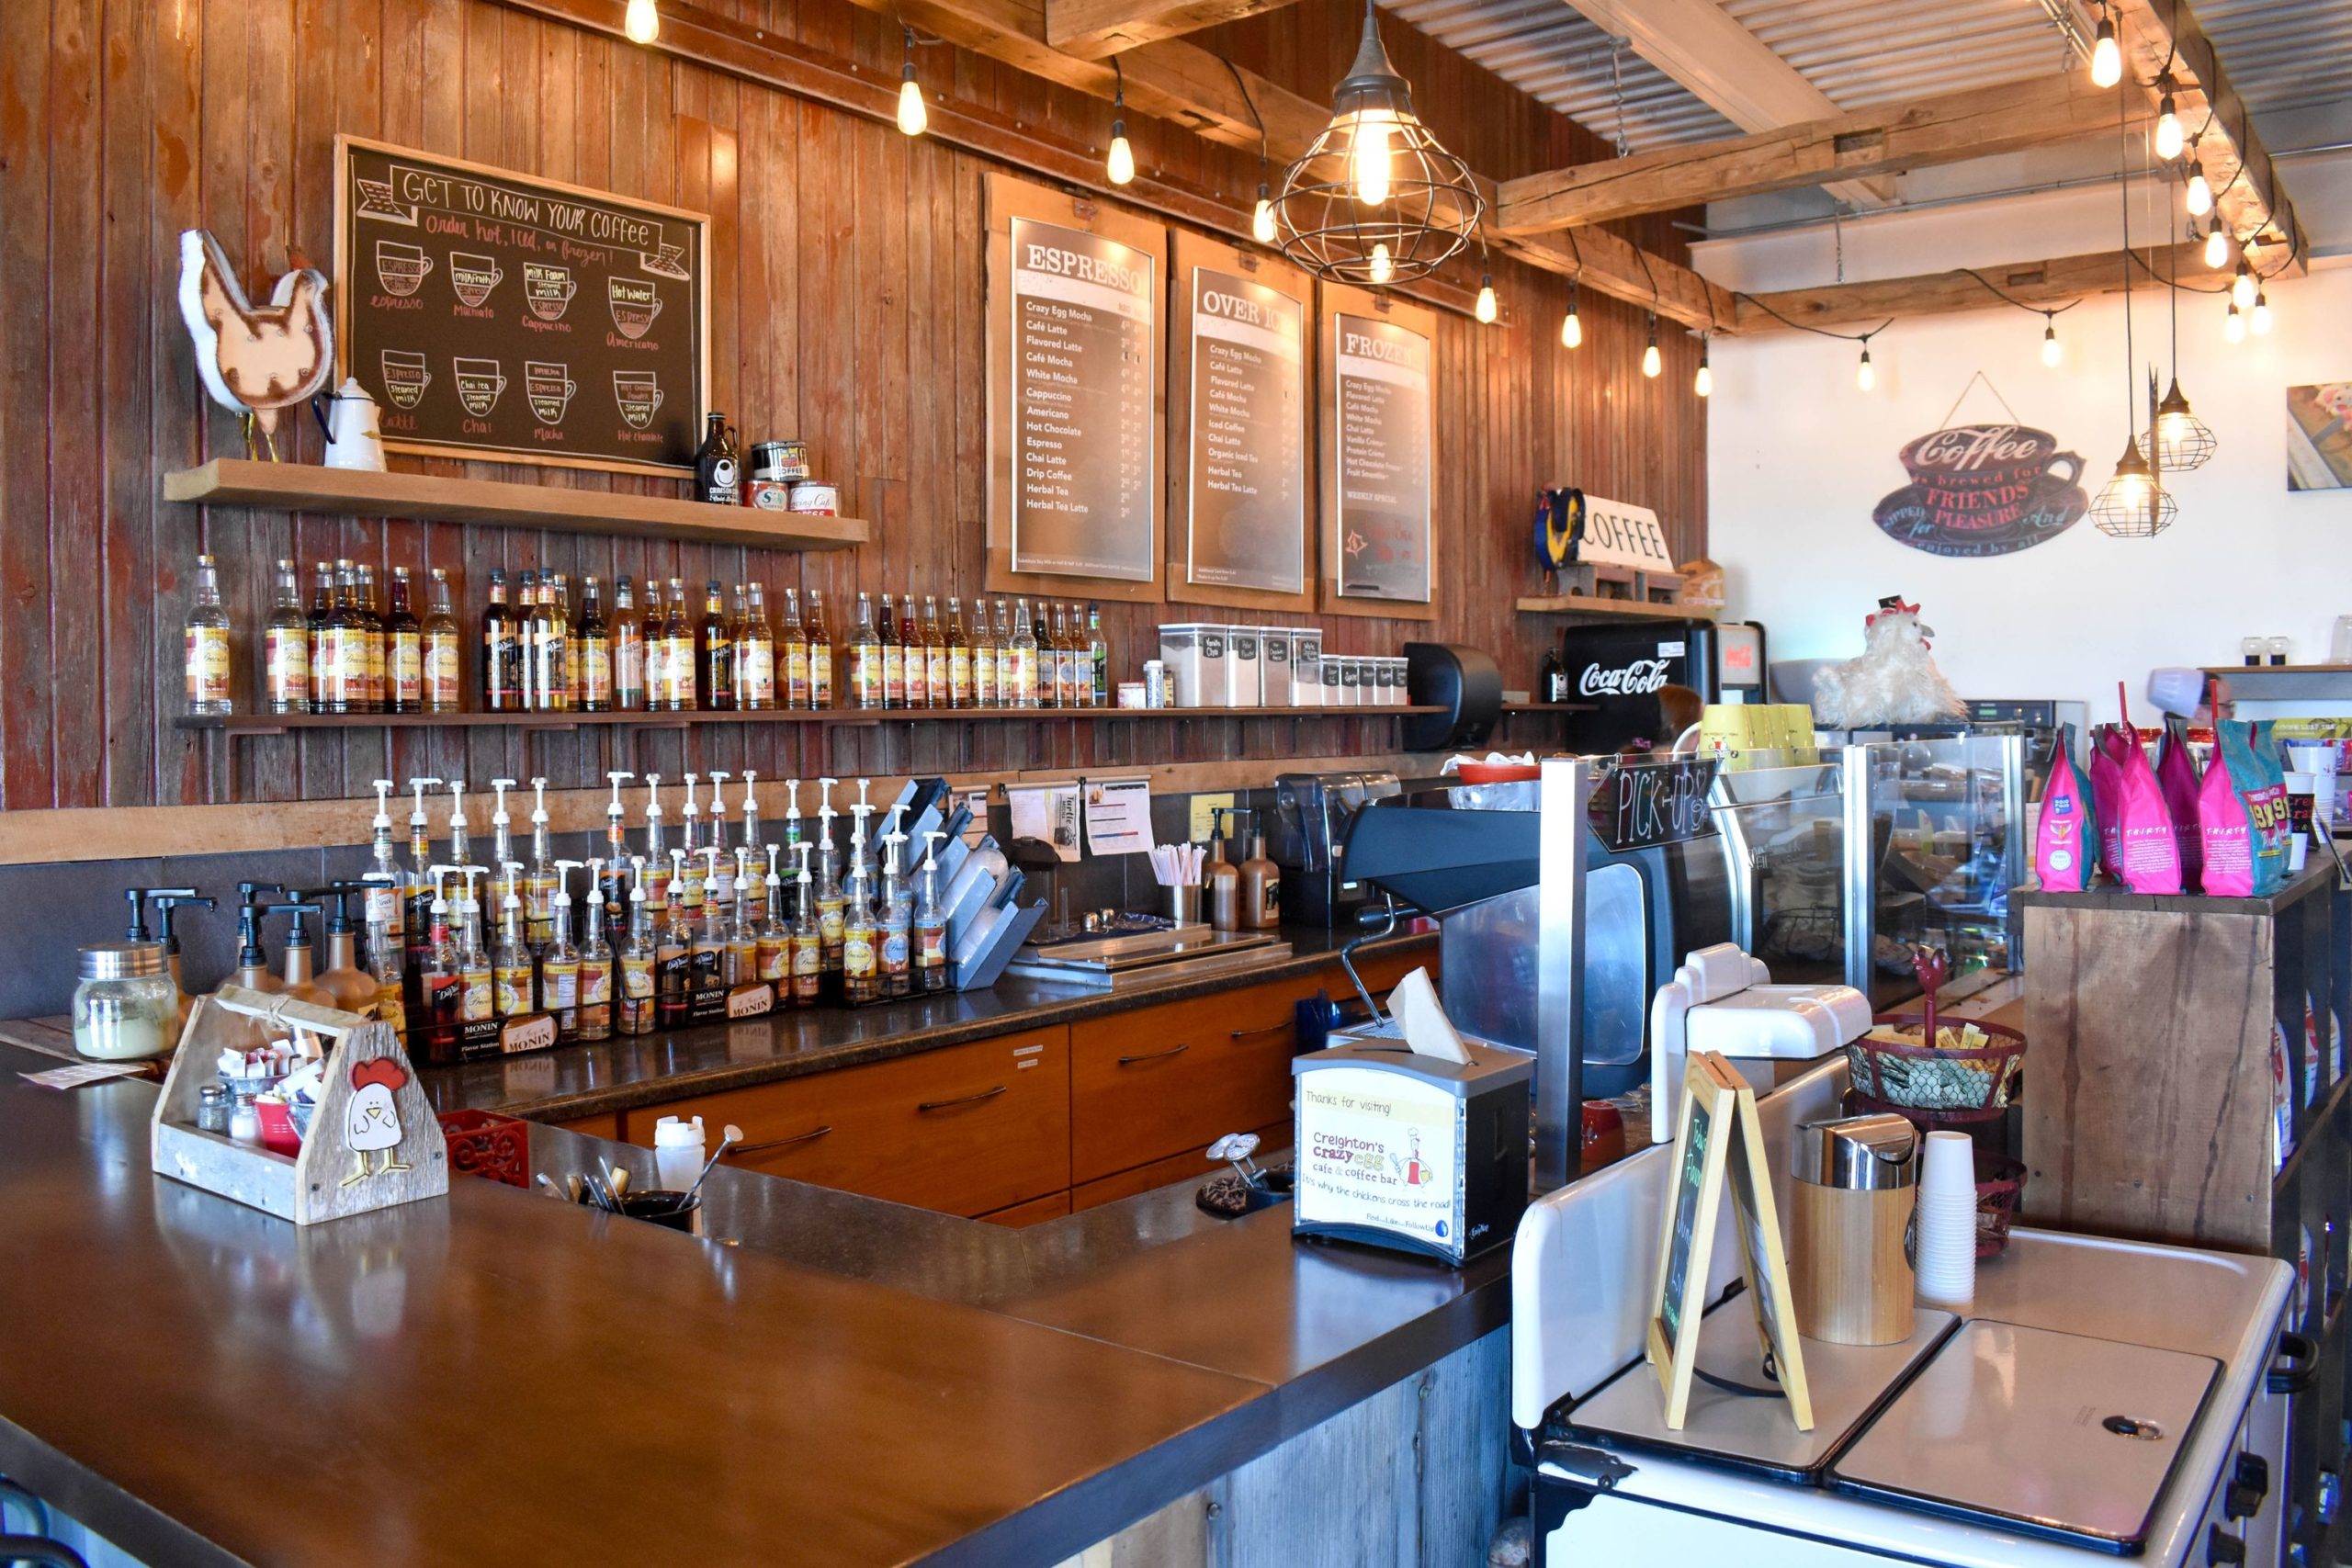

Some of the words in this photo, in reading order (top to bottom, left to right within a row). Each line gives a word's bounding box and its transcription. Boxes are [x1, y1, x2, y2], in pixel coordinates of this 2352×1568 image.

[461, 186, 484, 211] TO
[492, 190, 538, 223] KNOW
[548, 203, 583, 235] YOUR
[426, 216, 469, 239] Order
[1027, 244, 1141, 294] ESPRESSO
[612, 285, 626, 299] Hot
[1026, 301, 1049, 315] Crazy
[1052, 306, 1067, 319] Egg
[1069, 309, 1092, 321] Mocha
[1204, 291, 1260, 323] OVER
[1047, 323, 1068, 335] Latte
[1026, 335, 1061, 348] Flavored
[1063, 341, 1082, 352] Latte
[1346, 333, 1412, 365] FROZEN
[1047, 355, 1073, 367] Mocha
[1210, 345, 1228, 356] Crazy
[1230, 348, 1242, 360] Egg
[1026, 369, 1050, 380] White
[1053, 371, 1078, 384] Mocha
[1026, 388, 1071, 401] Cappuccino
[1027, 407, 1069, 419] Americano
[463, 418, 492, 434] Chai
[1027, 422, 1042, 431] Hot
[1045, 423, 1081, 436] Chocolate
[1027, 437, 1062, 449] Espresso
[1915, 426, 2038, 471] Coffee
[1026, 453, 1045, 463] Chai
[1046, 455, 1066, 465] Latte
[1208, 448, 1234, 459] Organic
[1027, 468, 1045, 479] Drip
[1046, 470, 1071, 480] Coffee
[1208, 467, 1230, 477] Herbal
[1939, 472, 2004, 486] brewed
[2013, 465, 2041, 480] for
[1027, 484, 1054, 494] Herbal
[1056, 486, 1069, 496] Tea
[1208, 480, 1230, 491] Herbal
[1926, 482, 2029, 509] FRIENDS
[1026, 500, 1054, 510] Herbal
[1056, 502, 1069, 511] Tea
[1070, 502, 1088, 513] Latte
[1935, 502, 2023, 530] PLEASURE
[1580, 659, 1670, 696] Coca-Cola
[1616, 768, 1694, 844] PICK-UP
[695, 990, 724, 1000] MONIN
[733, 999, 767, 1017] MONIN
[464, 1022, 499, 1034] MONIN
[509, 1032, 550, 1052] MONIN
[1306, 1091, 1337, 1105] Thanks
[1341, 1095, 1355, 1109] for
[1360, 1100, 1392, 1116] visiting!
[1314, 1132, 1385, 1154] Creighton's
[1313, 1145, 1354, 1164] crazy
[1354, 1153, 1385, 1172] egg
[1345, 1168, 1377, 1182] coffee
[1380, 1173, 1397, 1186] bar
[1317, 1181, 1334, 1193] why
[1337, 1184, 1350, 1197] the
[1352, 1188, 1385, 1204] chickens
[1388, 1197, 1410, 1208] cross
[1413, 1197, 1428, 1209] the
